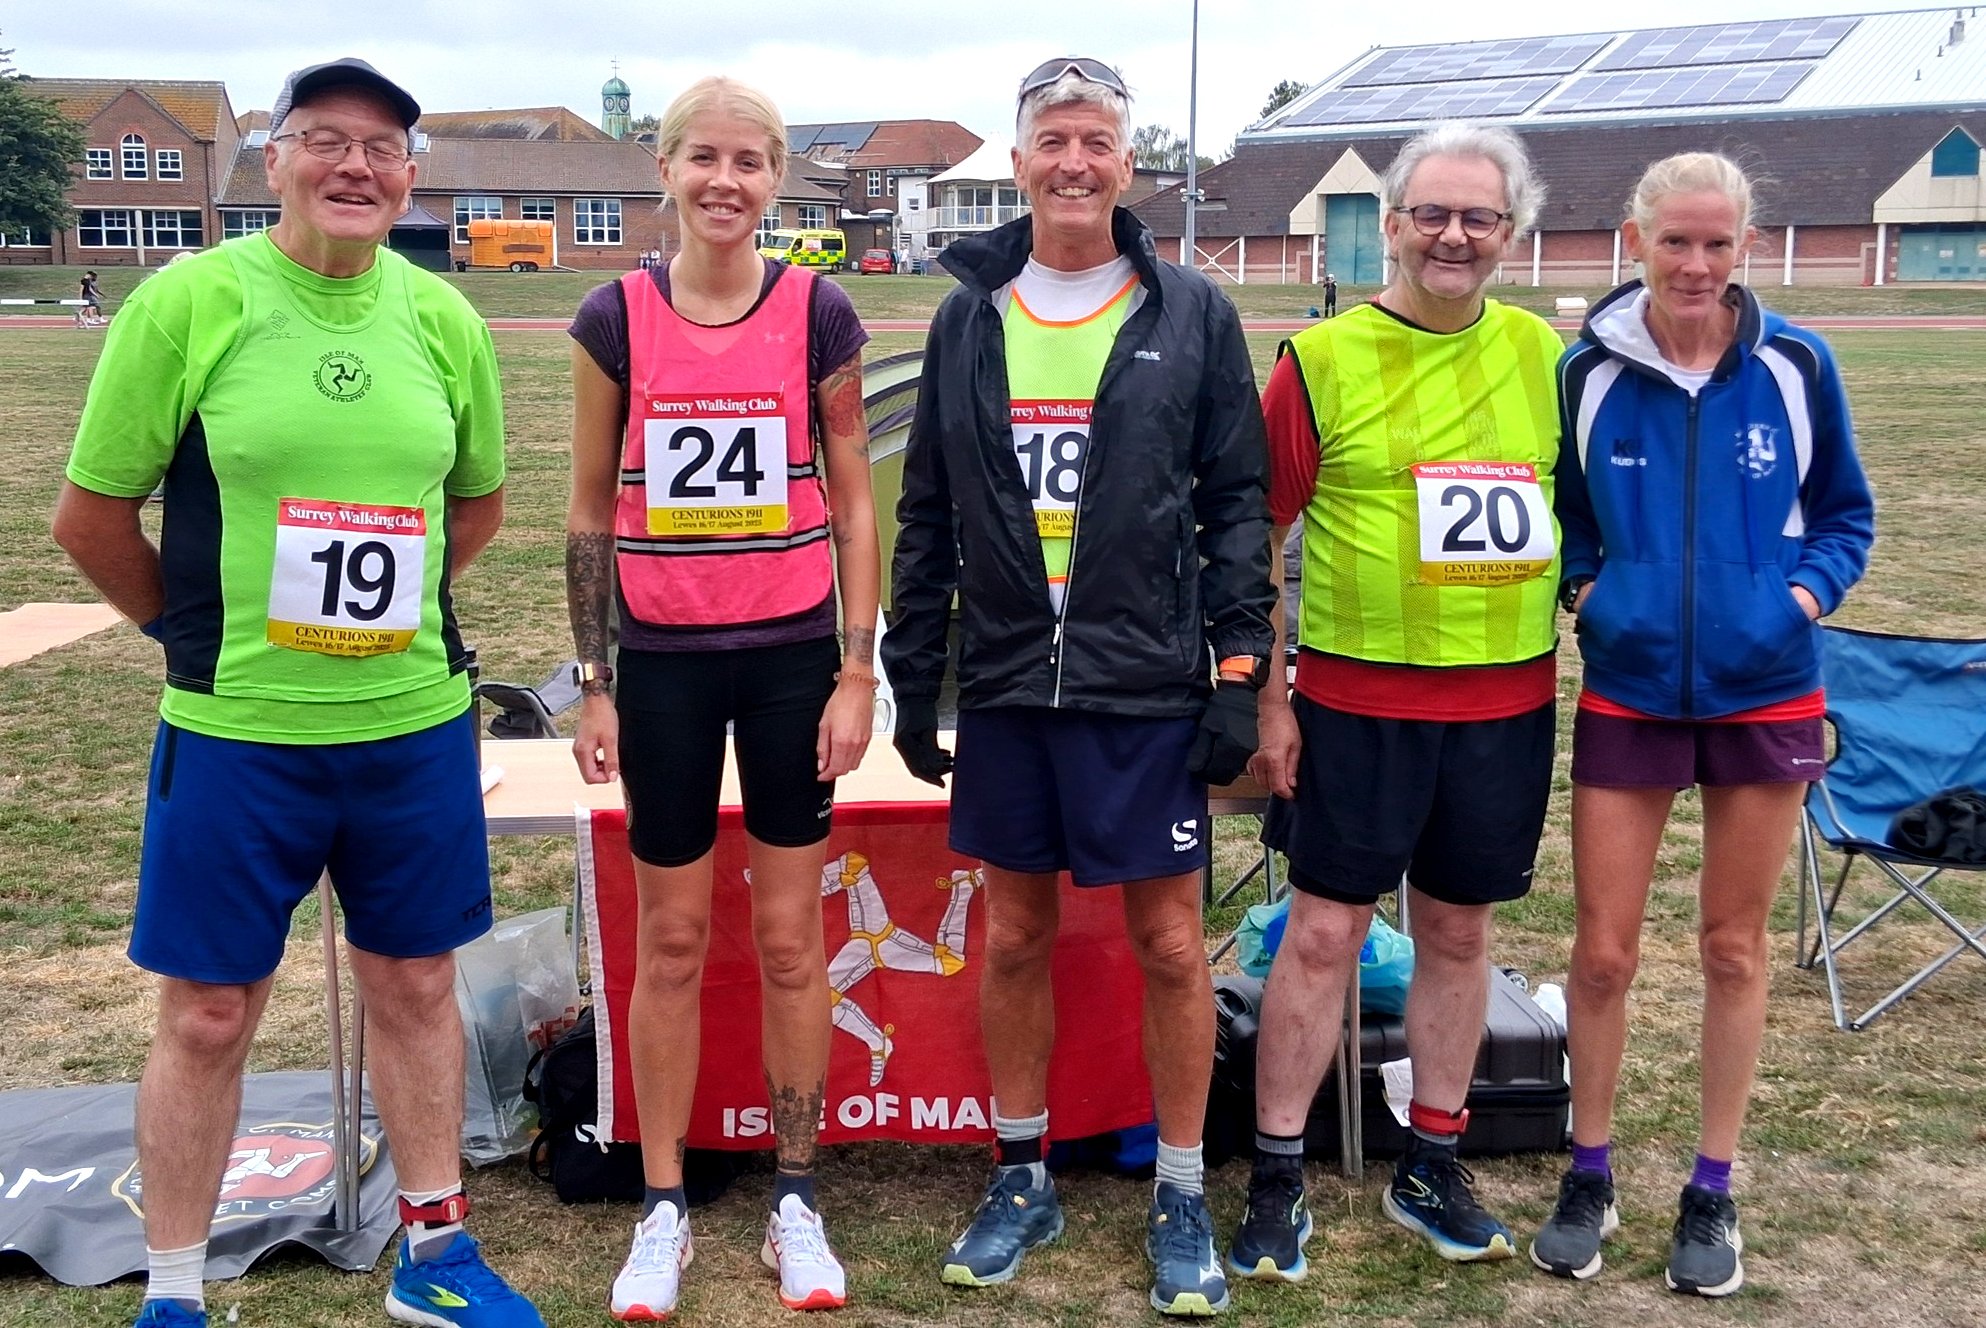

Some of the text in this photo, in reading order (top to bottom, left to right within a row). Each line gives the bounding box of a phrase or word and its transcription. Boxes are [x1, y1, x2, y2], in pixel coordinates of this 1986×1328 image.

[651, 398, 777, 415] Surrey Walking Club
[1011, 407, 1036, 420] rrey
[1038, 404, 1089, 420] Walking
[668, 426, 765, 498] 24
[1016, 431, 1090, 503] 18
[1610, 456, 1647, 467] KUDS
[1418, 464, 1531, 478] Surrey Walking Club
[288, 505, 419, 529] Surrey Walking Club
[671, 508, 763, 520] CENTURIONS 1911
[1440, 485, 1531, 553] 20
[1444, 563, 1531, 573] CENTURIONS 1911
[310, 540, 397, 622] 19
[295, 626, 395, 643] CENTURIONS 1911
[837, 1092, 900, 1128] OF
[910, 1096, 997, 1130] MA
